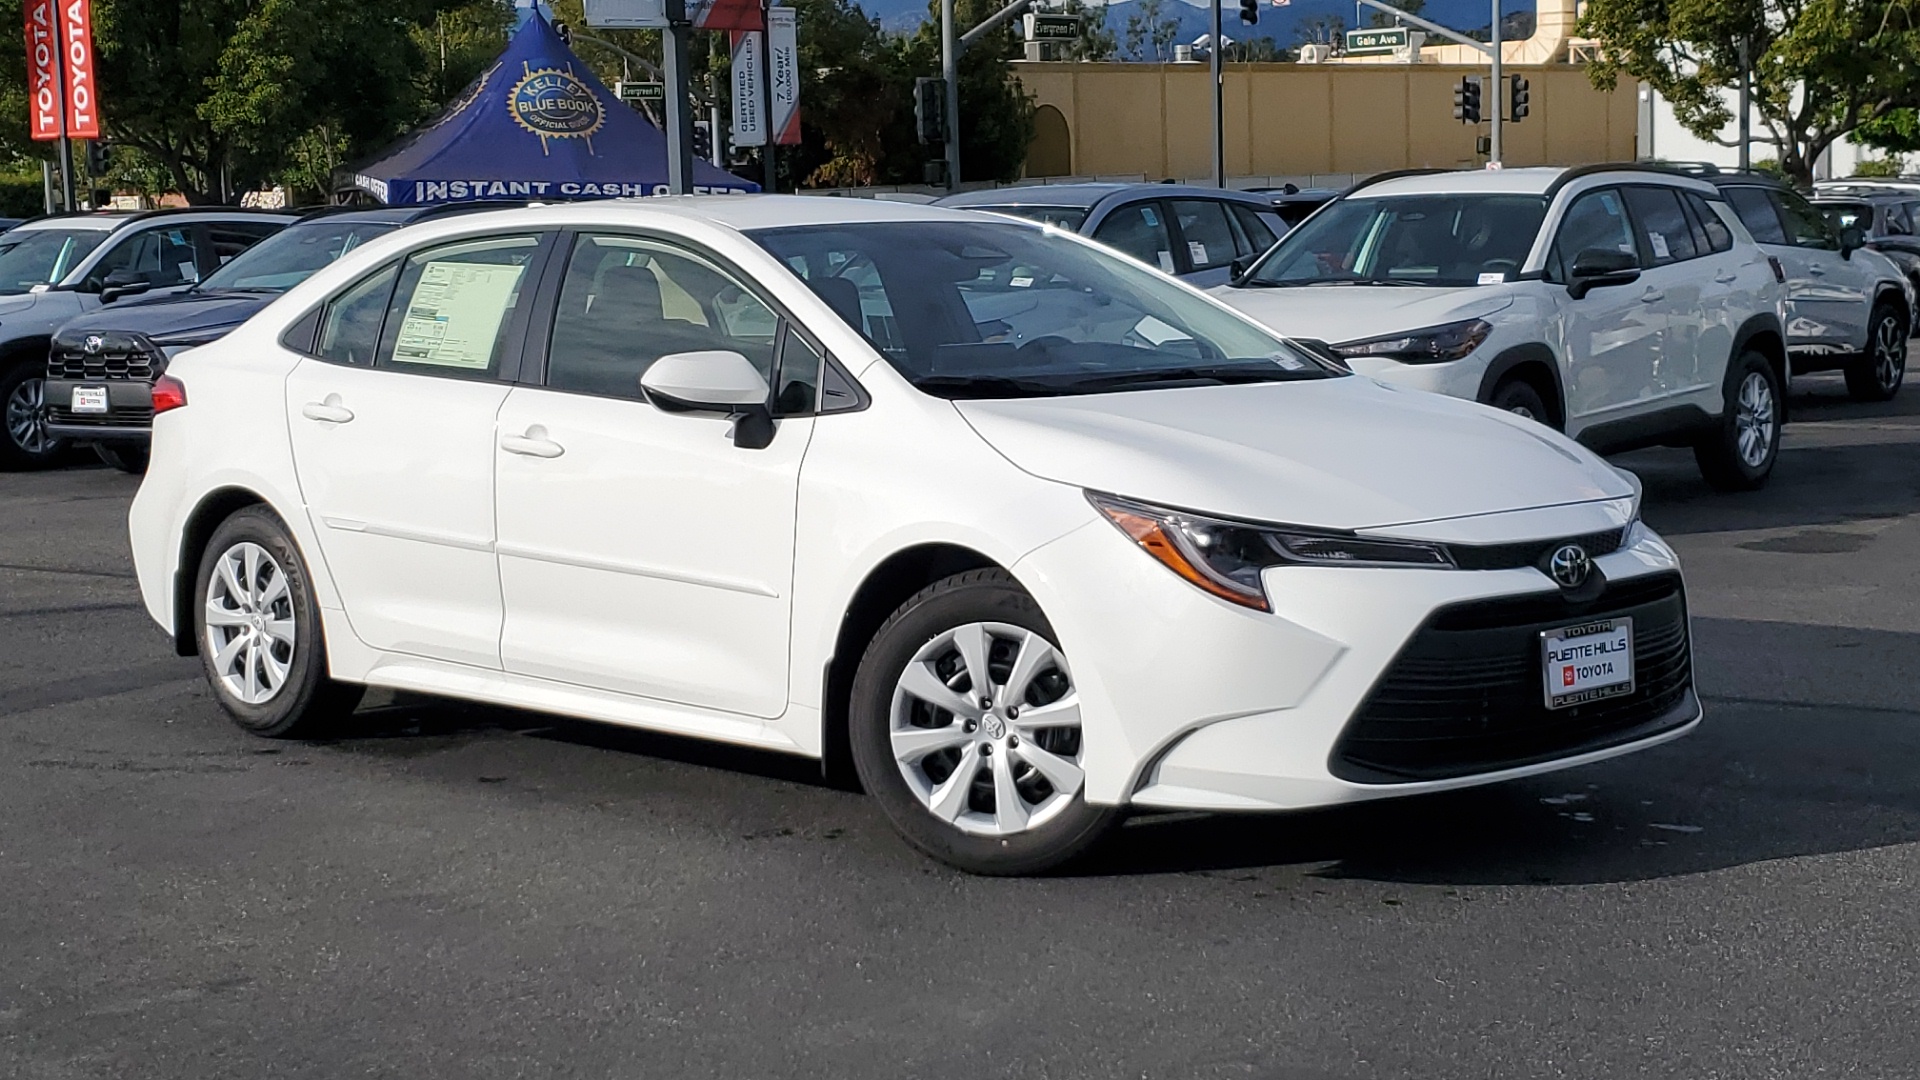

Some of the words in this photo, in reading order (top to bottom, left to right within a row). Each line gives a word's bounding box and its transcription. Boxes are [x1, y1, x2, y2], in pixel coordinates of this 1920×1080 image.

[1035, 22, 1067, 35] Evergreen
[1356, 36, 1376, 46] Gale
[1379, 34, 1397, 45] Ave
[33, 2, 54, 131] TOYOTA
[67, 0, 90, 130] TOYOTA
[745, 38, 754, 97] VEHICLES
[774, 47, 784, 88] Year/
[523, 76, 587, 97] KELLEY
[622, 86, 653, 97] Evergreen
[785, 69, 793, 105] 100,000
[519, 99, 557, 113] BLUE
[557, 99, 595, 114] BOOK
[738, 70, 748, 132] CERTIFIED
[776, 93, 785, 102] 7
[529, 114, 569, 129] OFFICIAL
[748, 99, 756, 132] USED
[355, 173, 370, 190] CASH
[415, 181, 550, 202] INSTANT
[560, 182, 643, 197] CASH
[1567, 622, 1610, 637] TOYOTA
[1548, 645, 1592, 663] PUENTE
[1594, 638, 1626, 655] HILLS
[1576, 662, 1613, 679] TOYOTA
[1554, 690, 1597, 706] PUENTE
